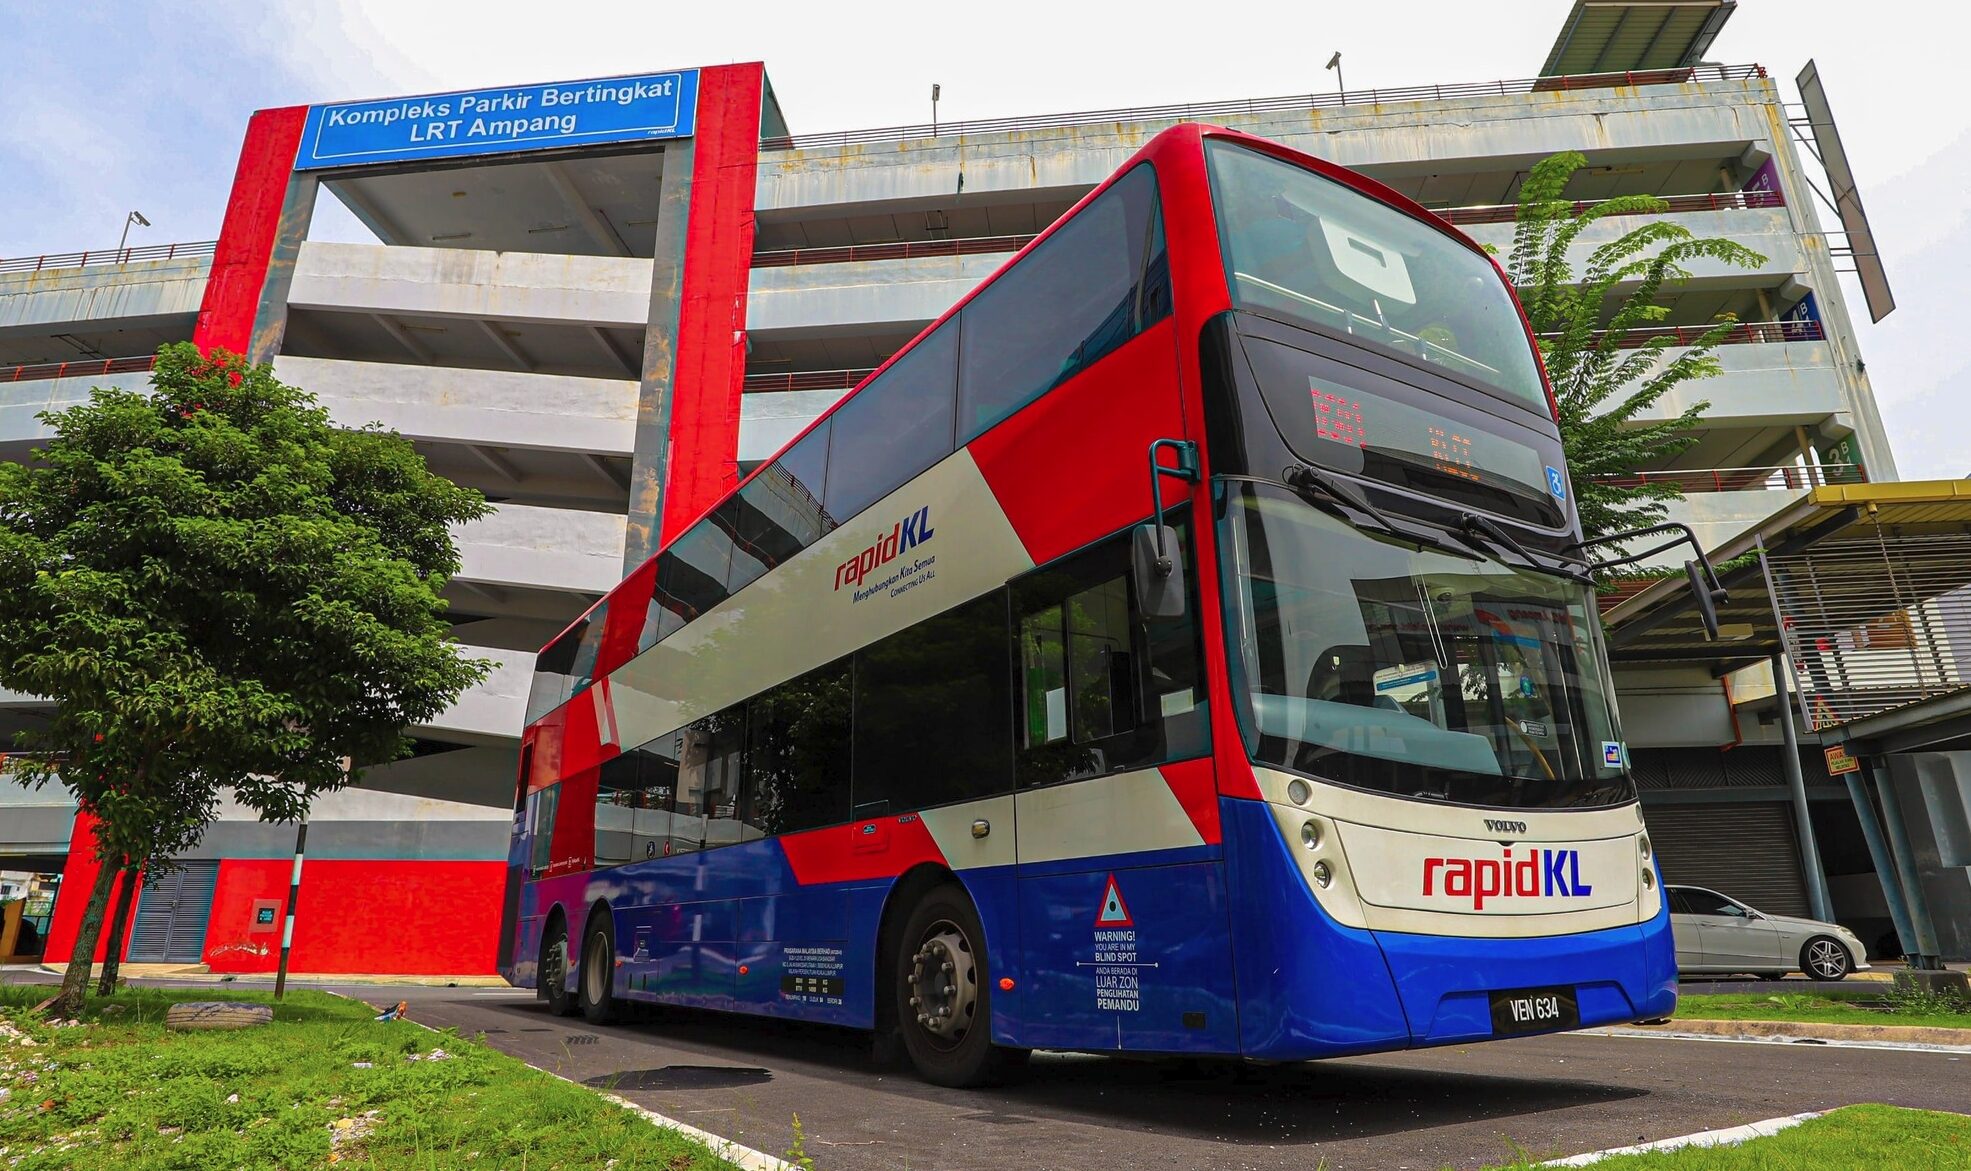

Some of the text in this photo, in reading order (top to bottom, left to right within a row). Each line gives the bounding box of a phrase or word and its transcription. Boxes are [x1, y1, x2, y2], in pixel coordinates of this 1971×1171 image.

[329, 79, 673, 126] Kompleks Parkir Bertingkat
[410, 114, 577, 142] LRT Ampang
[1761, 173, 1769, 186] B
[1800, 302, 1808, 316] B
[1840, 441, 1849, 455] B
[834, 505, 935, 591] rapidKL
[853, 555, 936, 604] Menghubungkan Kita Semua
[1483, 818, 1527, 834] VOLVO
[1422, 848, 1592, 910] rapidKL
[1094, 931, 1136, 942] WARNING!
[1095, 943, 1136, 951] YOU ARE IN MY
[1095, 952, 1137, 962] BLIND SPOT
[1110, 967, 1131, 975] BERADA
[1096, 976, 1139, 989] LUAR ZON
[1097, 988, 1139, 999] PENGLIHATAN
[1097, 999, 1139, 1011] PEMANDU
[1510, 996, 1559, 1022] VEN 634
